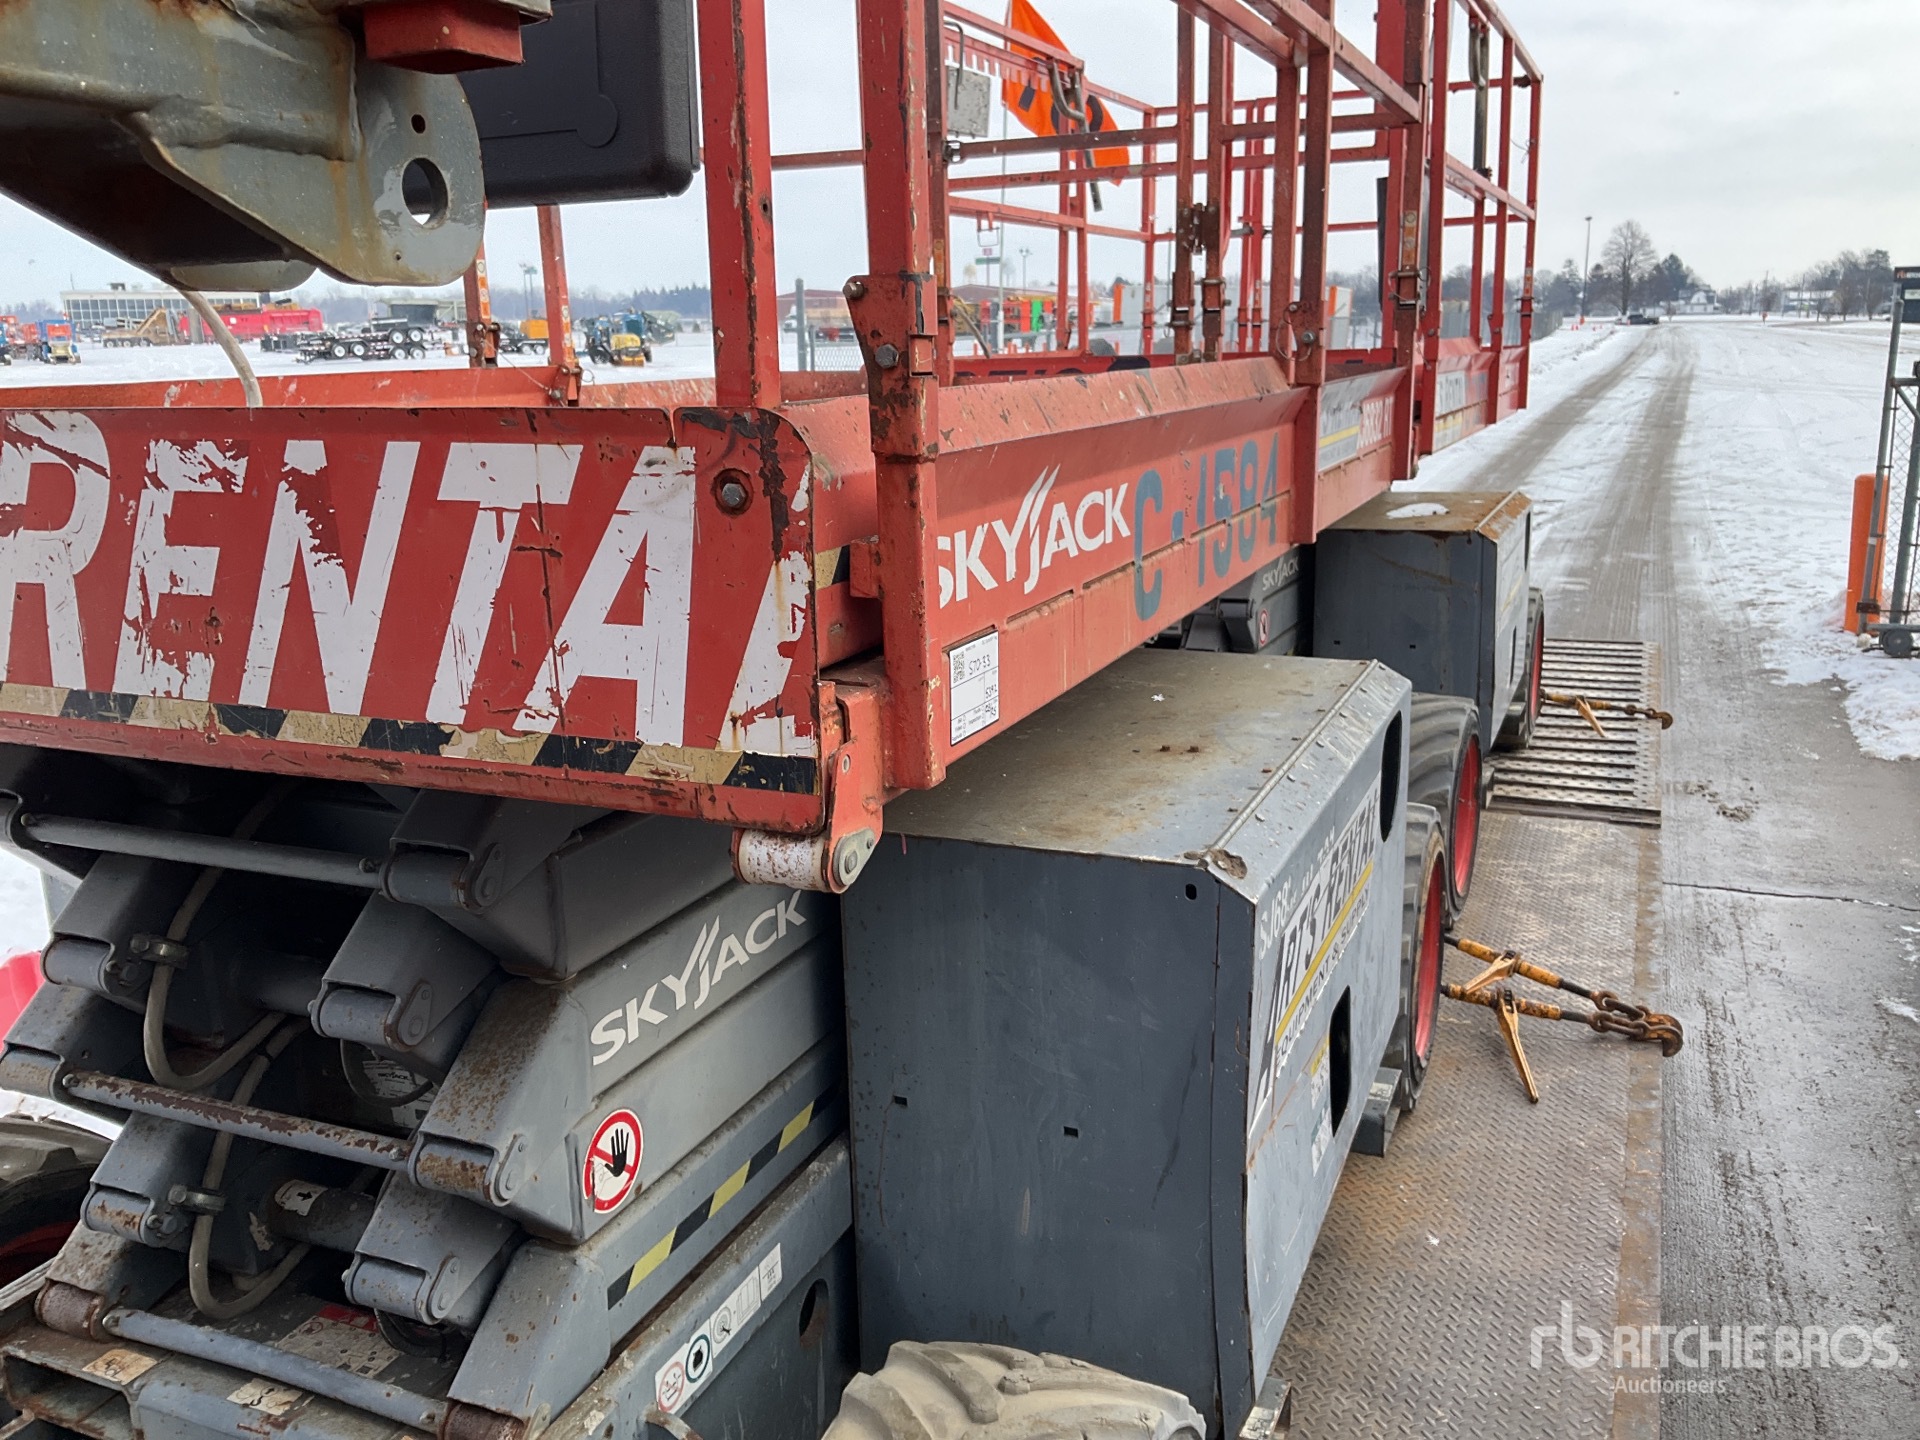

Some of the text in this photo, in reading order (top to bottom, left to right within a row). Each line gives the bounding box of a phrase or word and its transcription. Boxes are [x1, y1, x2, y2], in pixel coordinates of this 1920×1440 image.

[1262, 556, 1299, 592] SKYJACK
[1321, 788, 1378, 943] RENTAL
[591, 890, 807, 1066] SKYJACK
